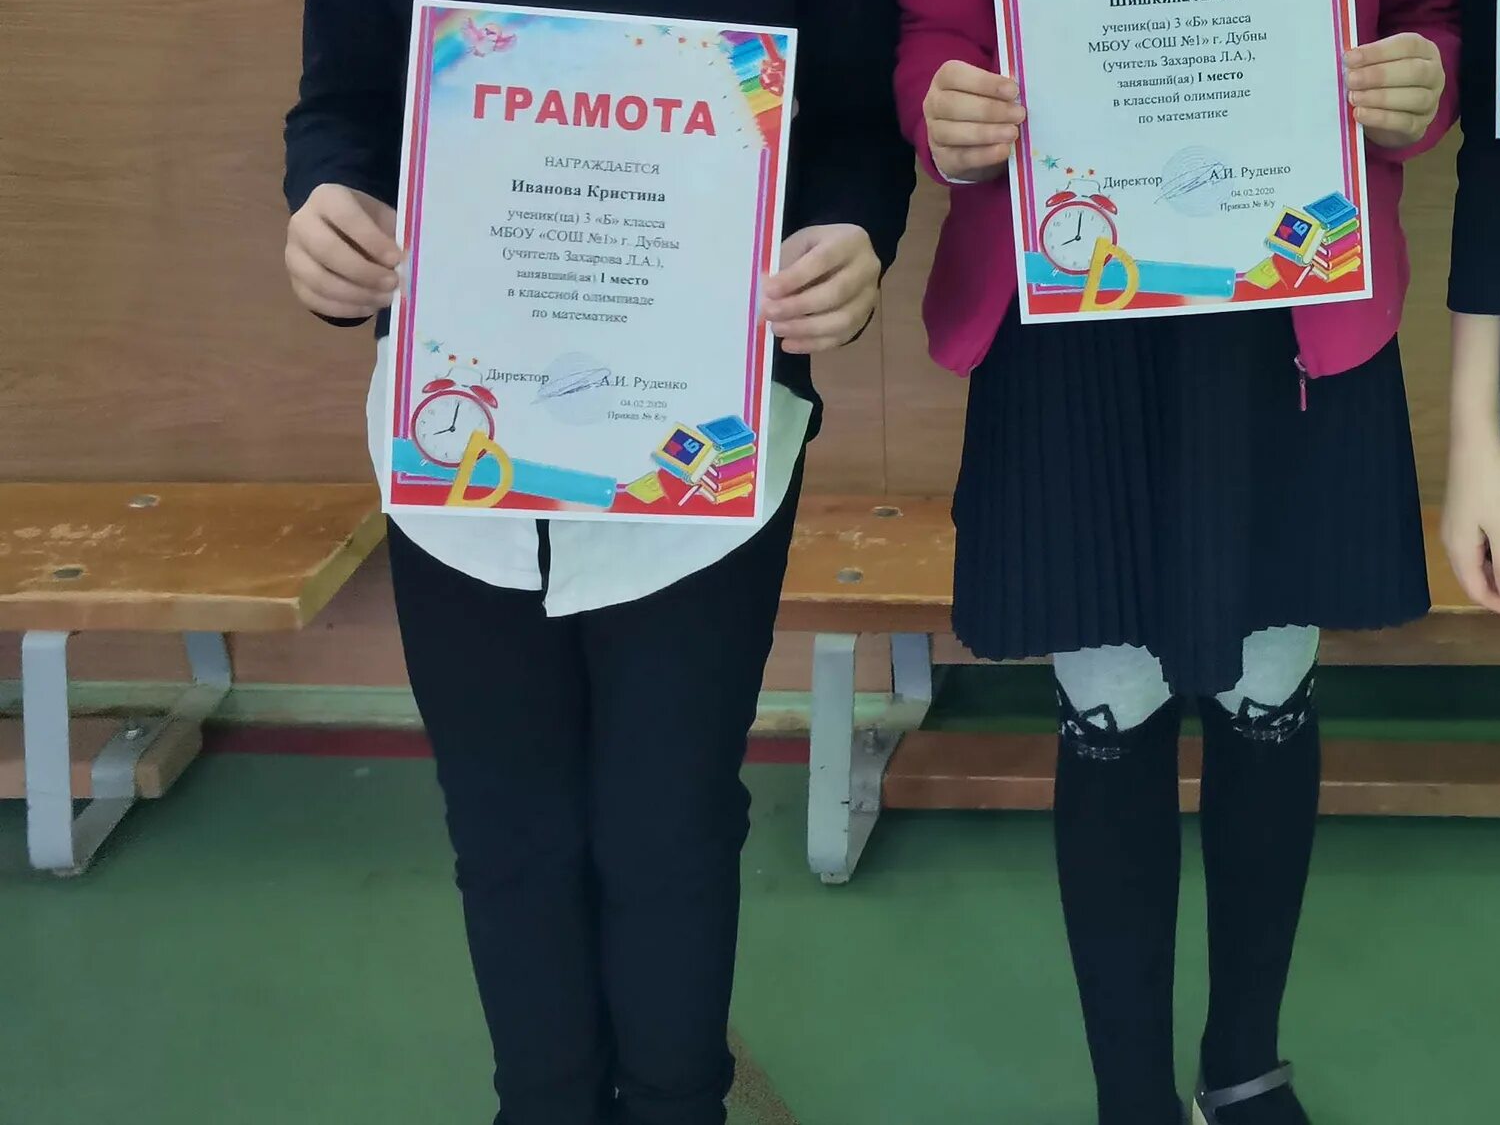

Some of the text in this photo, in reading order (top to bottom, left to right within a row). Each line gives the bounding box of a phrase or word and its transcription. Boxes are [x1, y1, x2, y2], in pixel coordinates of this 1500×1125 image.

[1102, 14, 1251, 36] ученик(ца) 3 «Б» класса
[1088, 39, 1130, 53] МБОУ
[1134, 36, 1176, 49] «СОШ
[1180, 34, 1209, 47] №1»
[1225, 30, 1267, 45] Дубны
[1102, 59, 1157, 73] (учитель
[1160, 54, 1216, 67] Захарова
[1117, 71, 1243, 88] занявший(ая) I место
[1113, 89, 1251, 107] в классной олимпиаде
[473, 84, 716, 136] ГРАМОТА
[1138, 109, 1228, 123] по математике
[544, 156, 659, 175] НАГРАЖДАЕТСЯ
[1102, 176, 1162, 189] Директор
[1241, 165, 1291, 179] Руденко
[511, 179, 665, 202] Иванова Кристина
[1230, 186, 1274, 197] 04.02.2020
[507, 209, 665, 228] ученик(ца) 3 «Б» класса
[490, 225, 535, 239] МБОУ
[538, 228, 583, 242] «СОШ
[634, 235, 679, 250] Дубны
[502, 246, 560, 260] (учитель
[564, 250, 622, 266] Захарова
[599, 272, 605, 283] I
[609, 276, 648, 285] место
[507, 288, 514, 296] в
[518, 289, 578, 300] классной
[531, 309, 627, 323] по математике
[485, 368, 549, 385] Директор
[633, 376, 687, 390] Руденко
